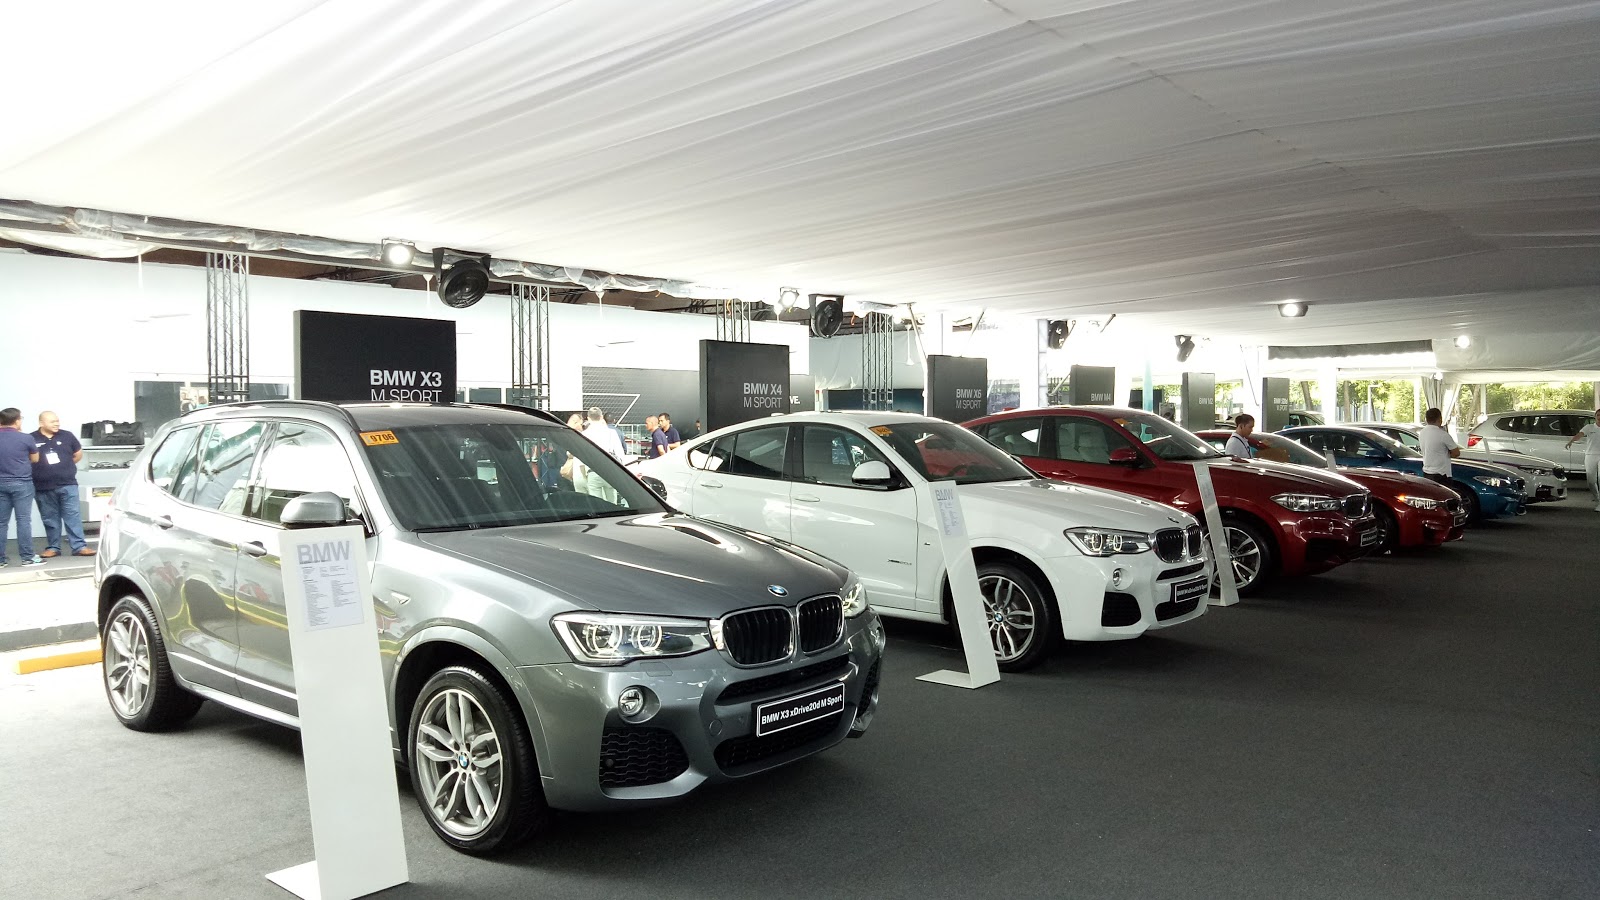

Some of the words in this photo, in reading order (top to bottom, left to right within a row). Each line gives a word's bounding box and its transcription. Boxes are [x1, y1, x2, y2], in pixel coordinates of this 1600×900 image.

[370, 369, 416, 387] BMW
[420, 371, 442, 388] X3
[744, 383, 768, 394] BMW
[770, 384, 782, 395] X4
[956, 388, 973, 398] BMW
[973, 388, 982, 399] X6
[371, 388, 385, 401] M
[389, 388, 443, 403] SPORT
[1090, 393, 1104, 402] BMW
[744, 397, 751, 407] M
[754, 397, 782, 408] SPORT
[955, 399, 962, 409] M
[962, 399, 982, 409] SPORT
[370, 434, 395, 442] 9706
[935, 489, 953, 500] BMW
[297, 541, 350, 564] BMW
[762, 712, 780, 724] BMW
[780, 709, 789, 719] X3
[790, 702, 820, 716] xDrive20d
[821, 699, 826, 708] M
[827, 694, 842, 705] Sport
